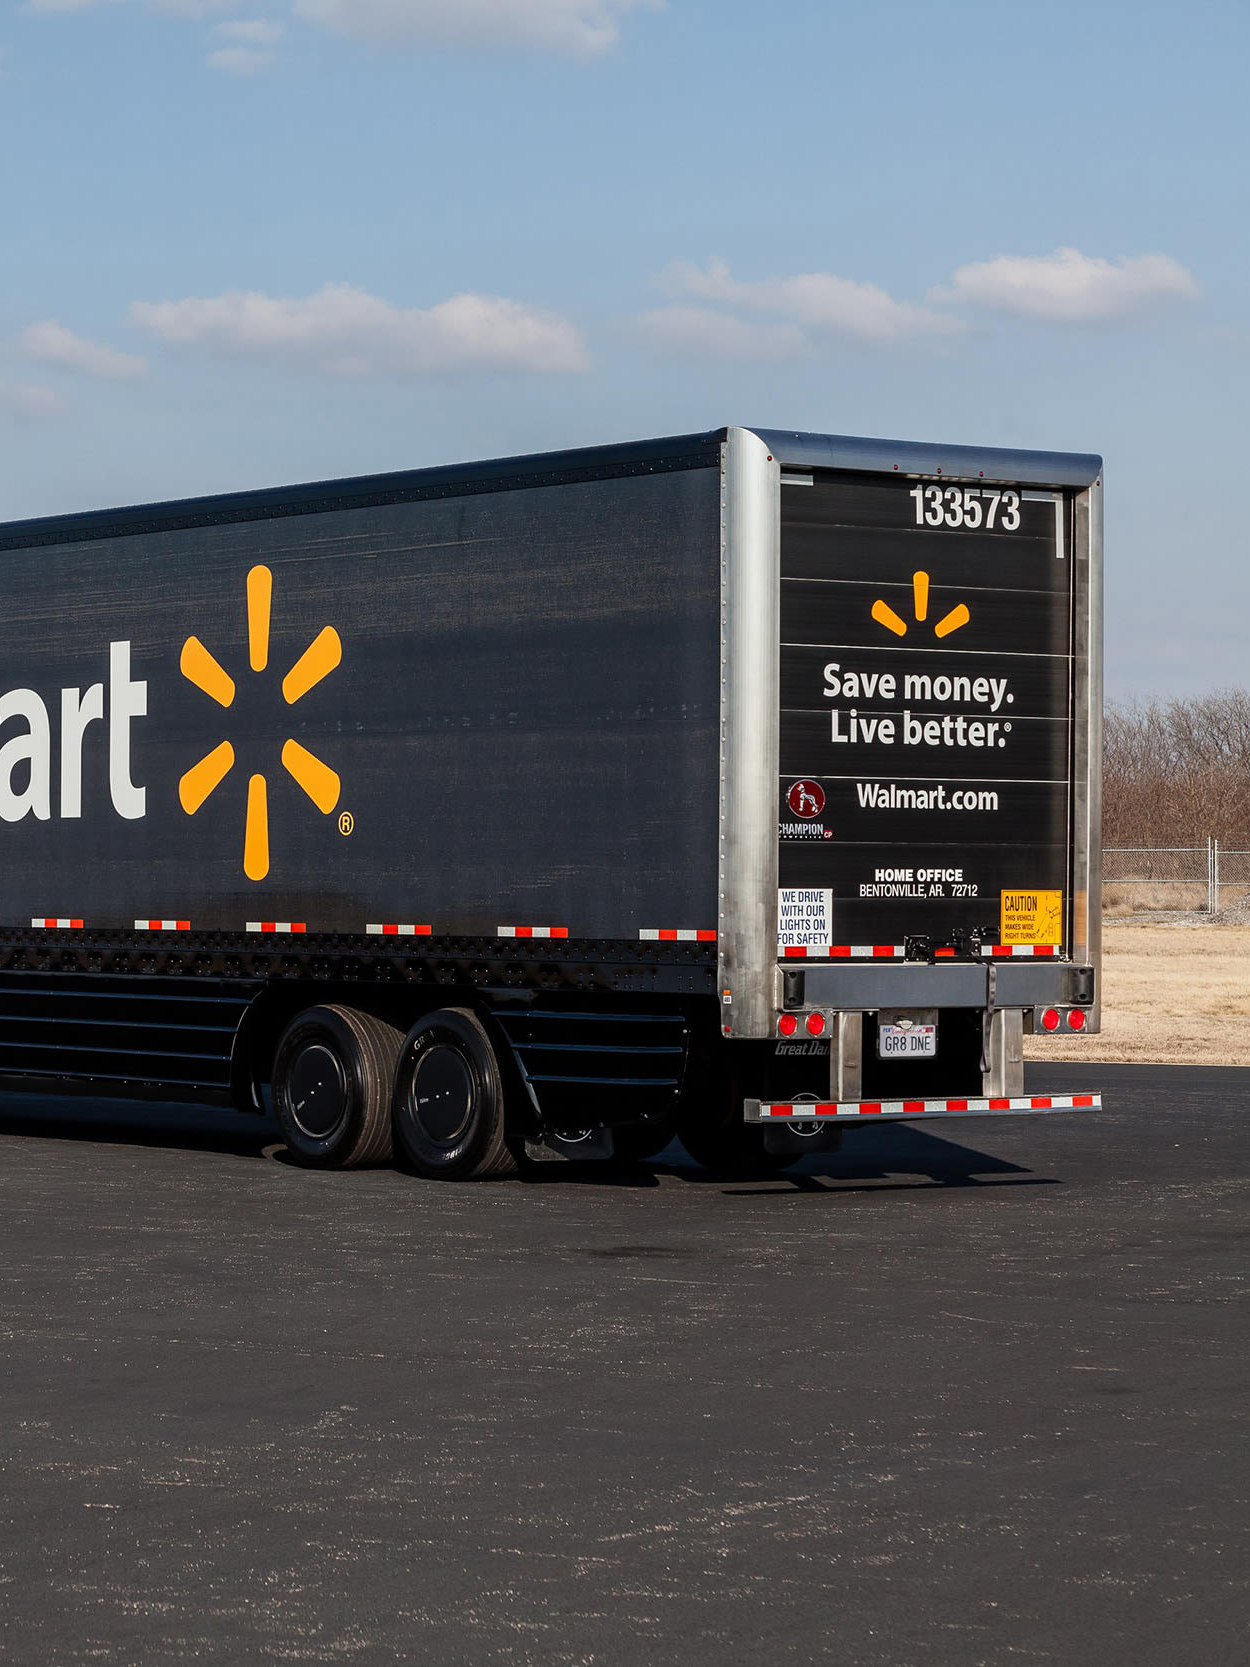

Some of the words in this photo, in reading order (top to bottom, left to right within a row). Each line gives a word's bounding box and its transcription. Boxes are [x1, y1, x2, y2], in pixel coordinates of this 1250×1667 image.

[910, 484, 1021, 530] 133573
[823, 663, 896, 698] Save
[904, 675, 1014, 712] money.
[831, 709, 895, 744] Live
[856, 783, 999, 811] Walmart.com
[875, 869, 914, 882] HOME
[916, 869, 963, 882] OFFICE
[782, 891, 796, 903] WE
[798, 891, 824, 903] DRIVE
[859, 884, 927, 899] BENTONVILLE,
[928, 884, 945, 897] AR.
[951, 884, 978, 897] 72712
[781, 905, 804, 917] WITH
[806, 905, 825, 917] OUR
[1005, 895, 1038, 912] CAUTION
[780, 919, 811, 931] LIGHTS
[813, 919, 826, 931] ON
[1016, 914, 1036, 922] VEHICLE
[777, 932, 795, 945] FOR
[796, 932, 829, 945] SAFETY
[1005, 932, 1019, 940] RIGHT
[775, 1040, 808, 1056] Great
[885, 1036, 907, 1051] GR8
[910, 1036, 931, 1051] DNE
